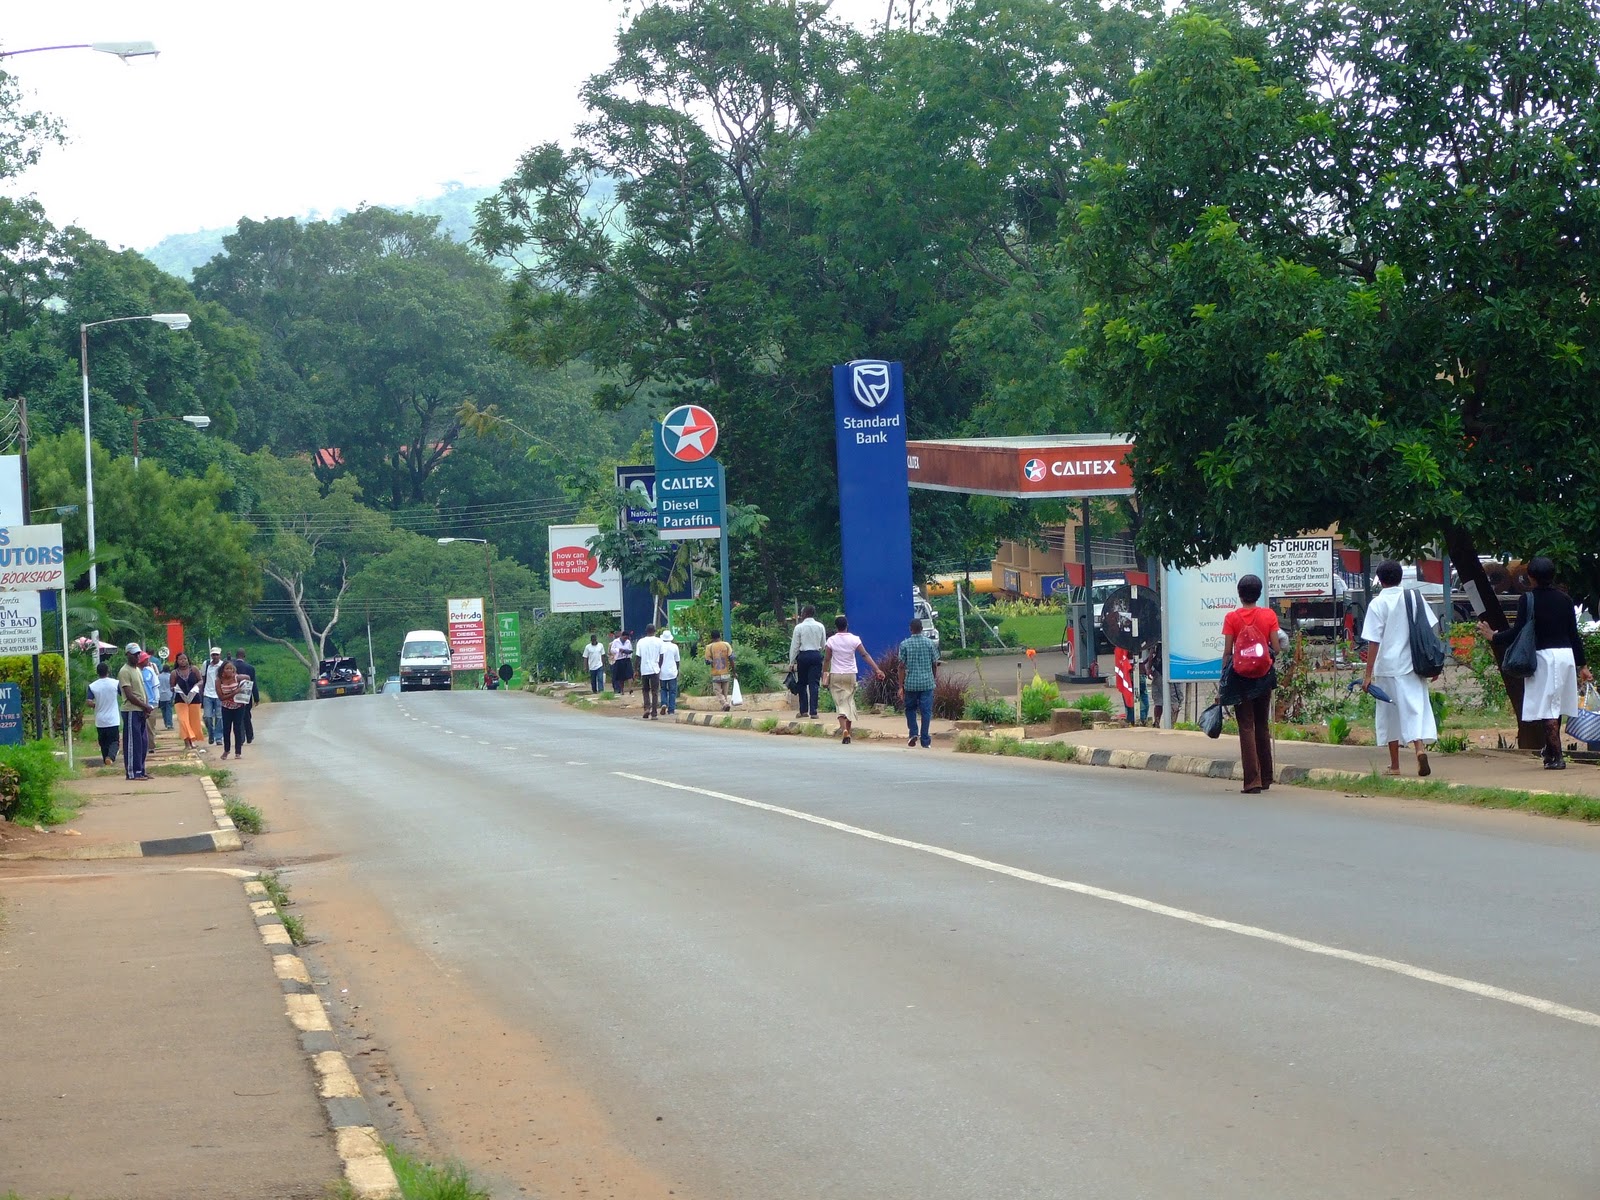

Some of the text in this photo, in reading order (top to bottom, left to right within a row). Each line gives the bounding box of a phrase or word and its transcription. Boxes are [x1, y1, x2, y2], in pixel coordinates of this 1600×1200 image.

[843, 414, 900, 429] Standard
[856, 431, 888, 444] Bank
[1051, 460, 1117, 476] CALTEX
[661, 476, 715, 490] CALTEX
[662, 499, 699, 511] Diesel
[663, 515, 713, 527] Paraffin
[1286, 540, 1329, 551] CHURCH
[0, 546, 63, 567] UTORS
[1, 570, 61, 584] BOOKSHOP
[1200, 573, 1237, 583] NATION
[1200, 597, 1238, 610] NATION
[11, 616, 37, 628] BAND
[450, 612, 482, 620] Petroda
